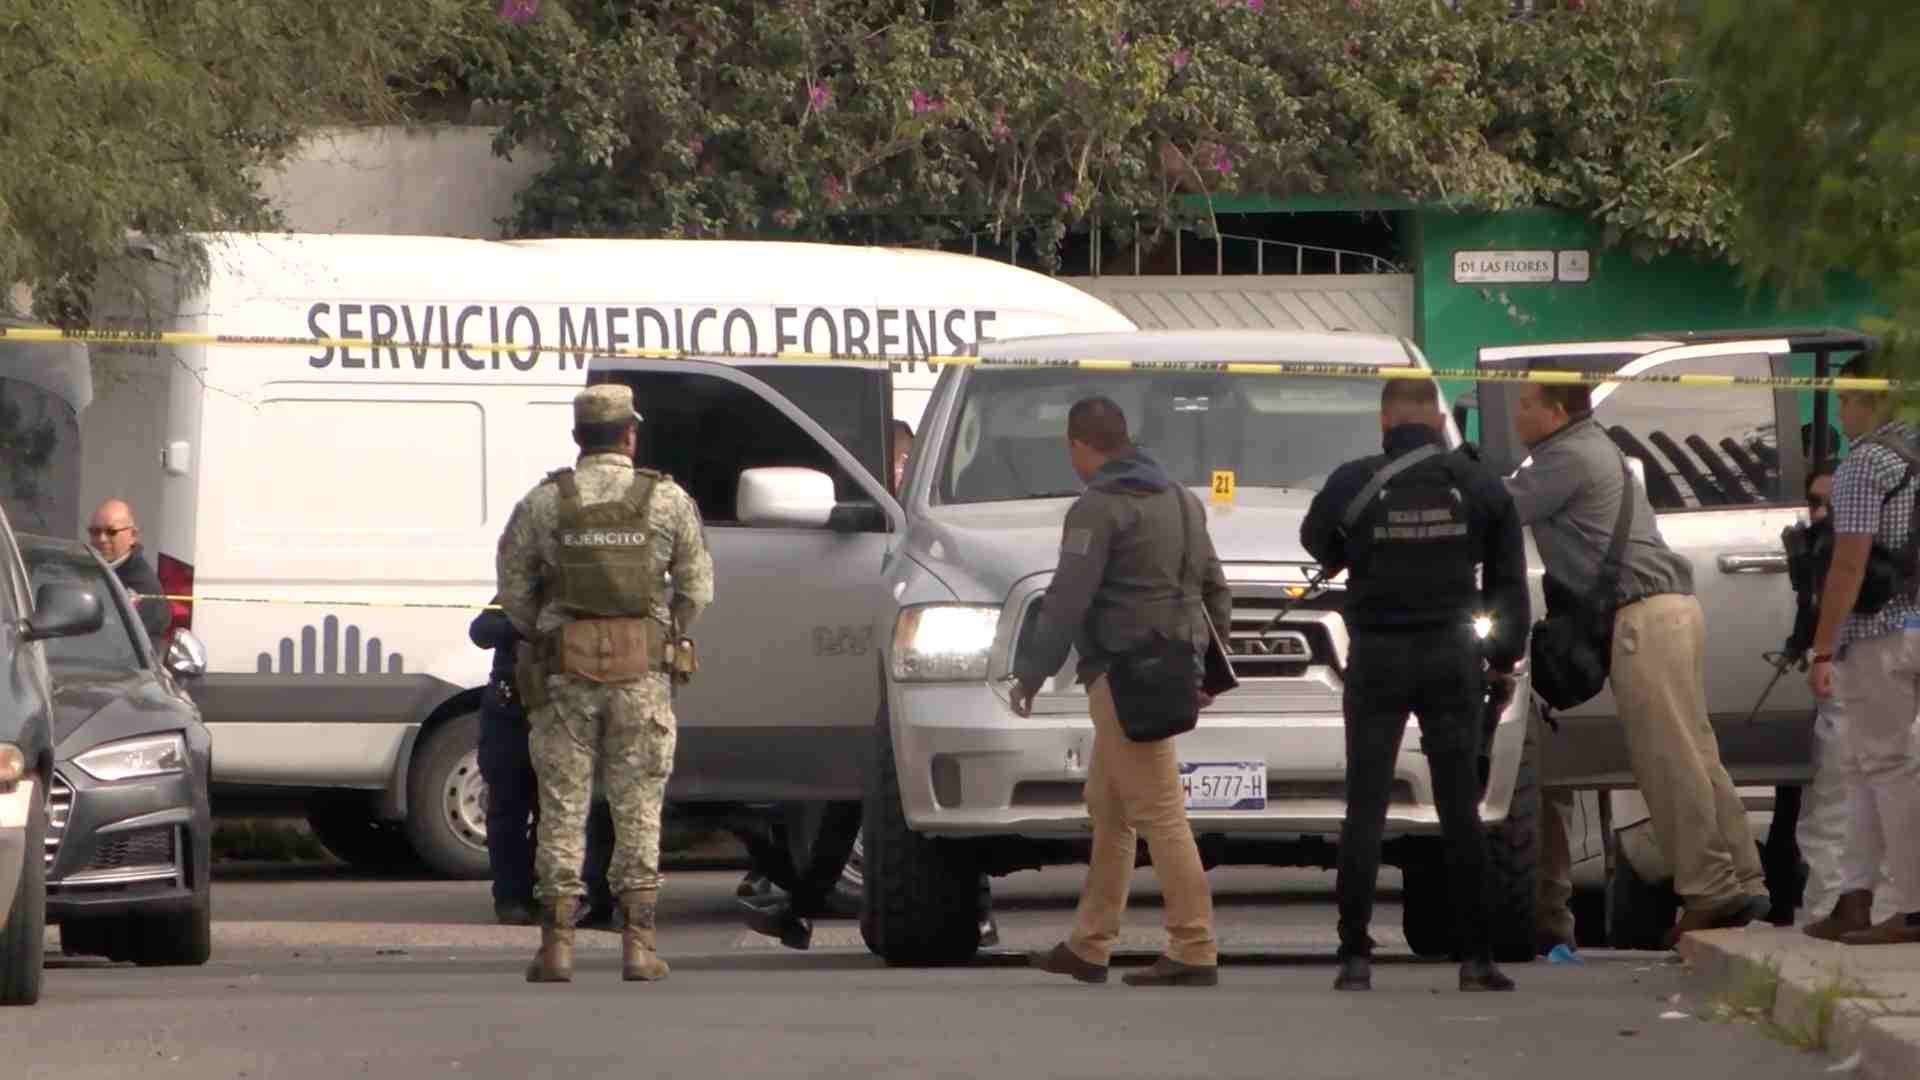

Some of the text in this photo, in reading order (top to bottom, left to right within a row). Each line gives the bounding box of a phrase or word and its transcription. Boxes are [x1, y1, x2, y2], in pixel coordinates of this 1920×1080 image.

[1480, 260, 1501, 272] LAS
[1503, 260, 1550, 272] FLORES
[307, 302, 997, 374] SERVICIO MEDICO FORENSE
[1215, 475, 1230, 494] 21
